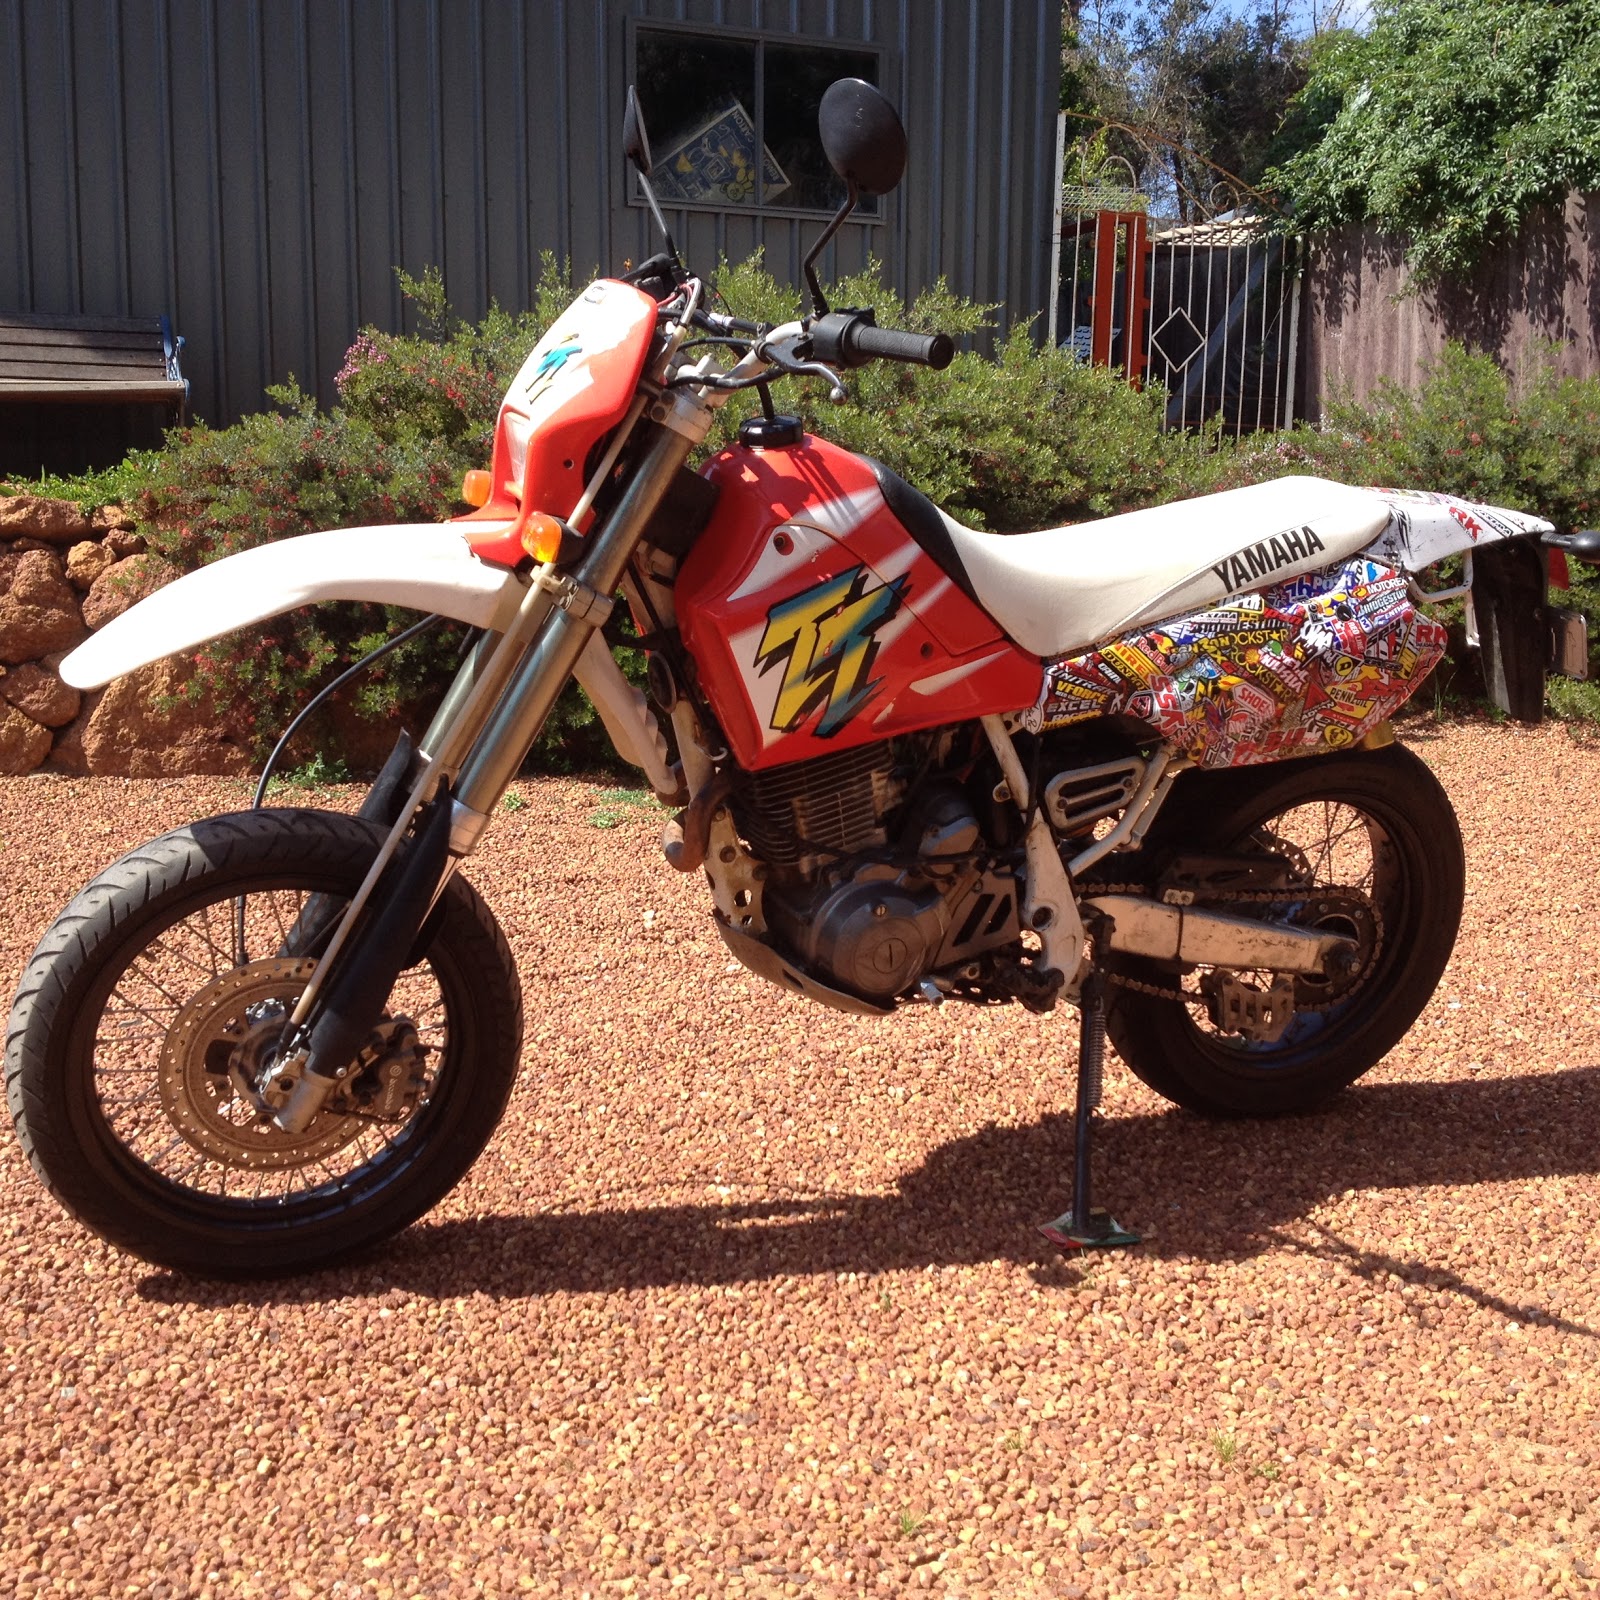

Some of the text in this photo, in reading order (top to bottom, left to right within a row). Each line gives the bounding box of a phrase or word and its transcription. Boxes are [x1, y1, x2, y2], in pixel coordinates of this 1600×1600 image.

[731, 110, 755, 143] CARTON
[1449, 506, 1483, 542] RK
[1211, 525, 1326, 594] YAMAHA
[1045, 699, 1101, 713] EXCEL
[1056, 680, 1109, 704] VFORCE
